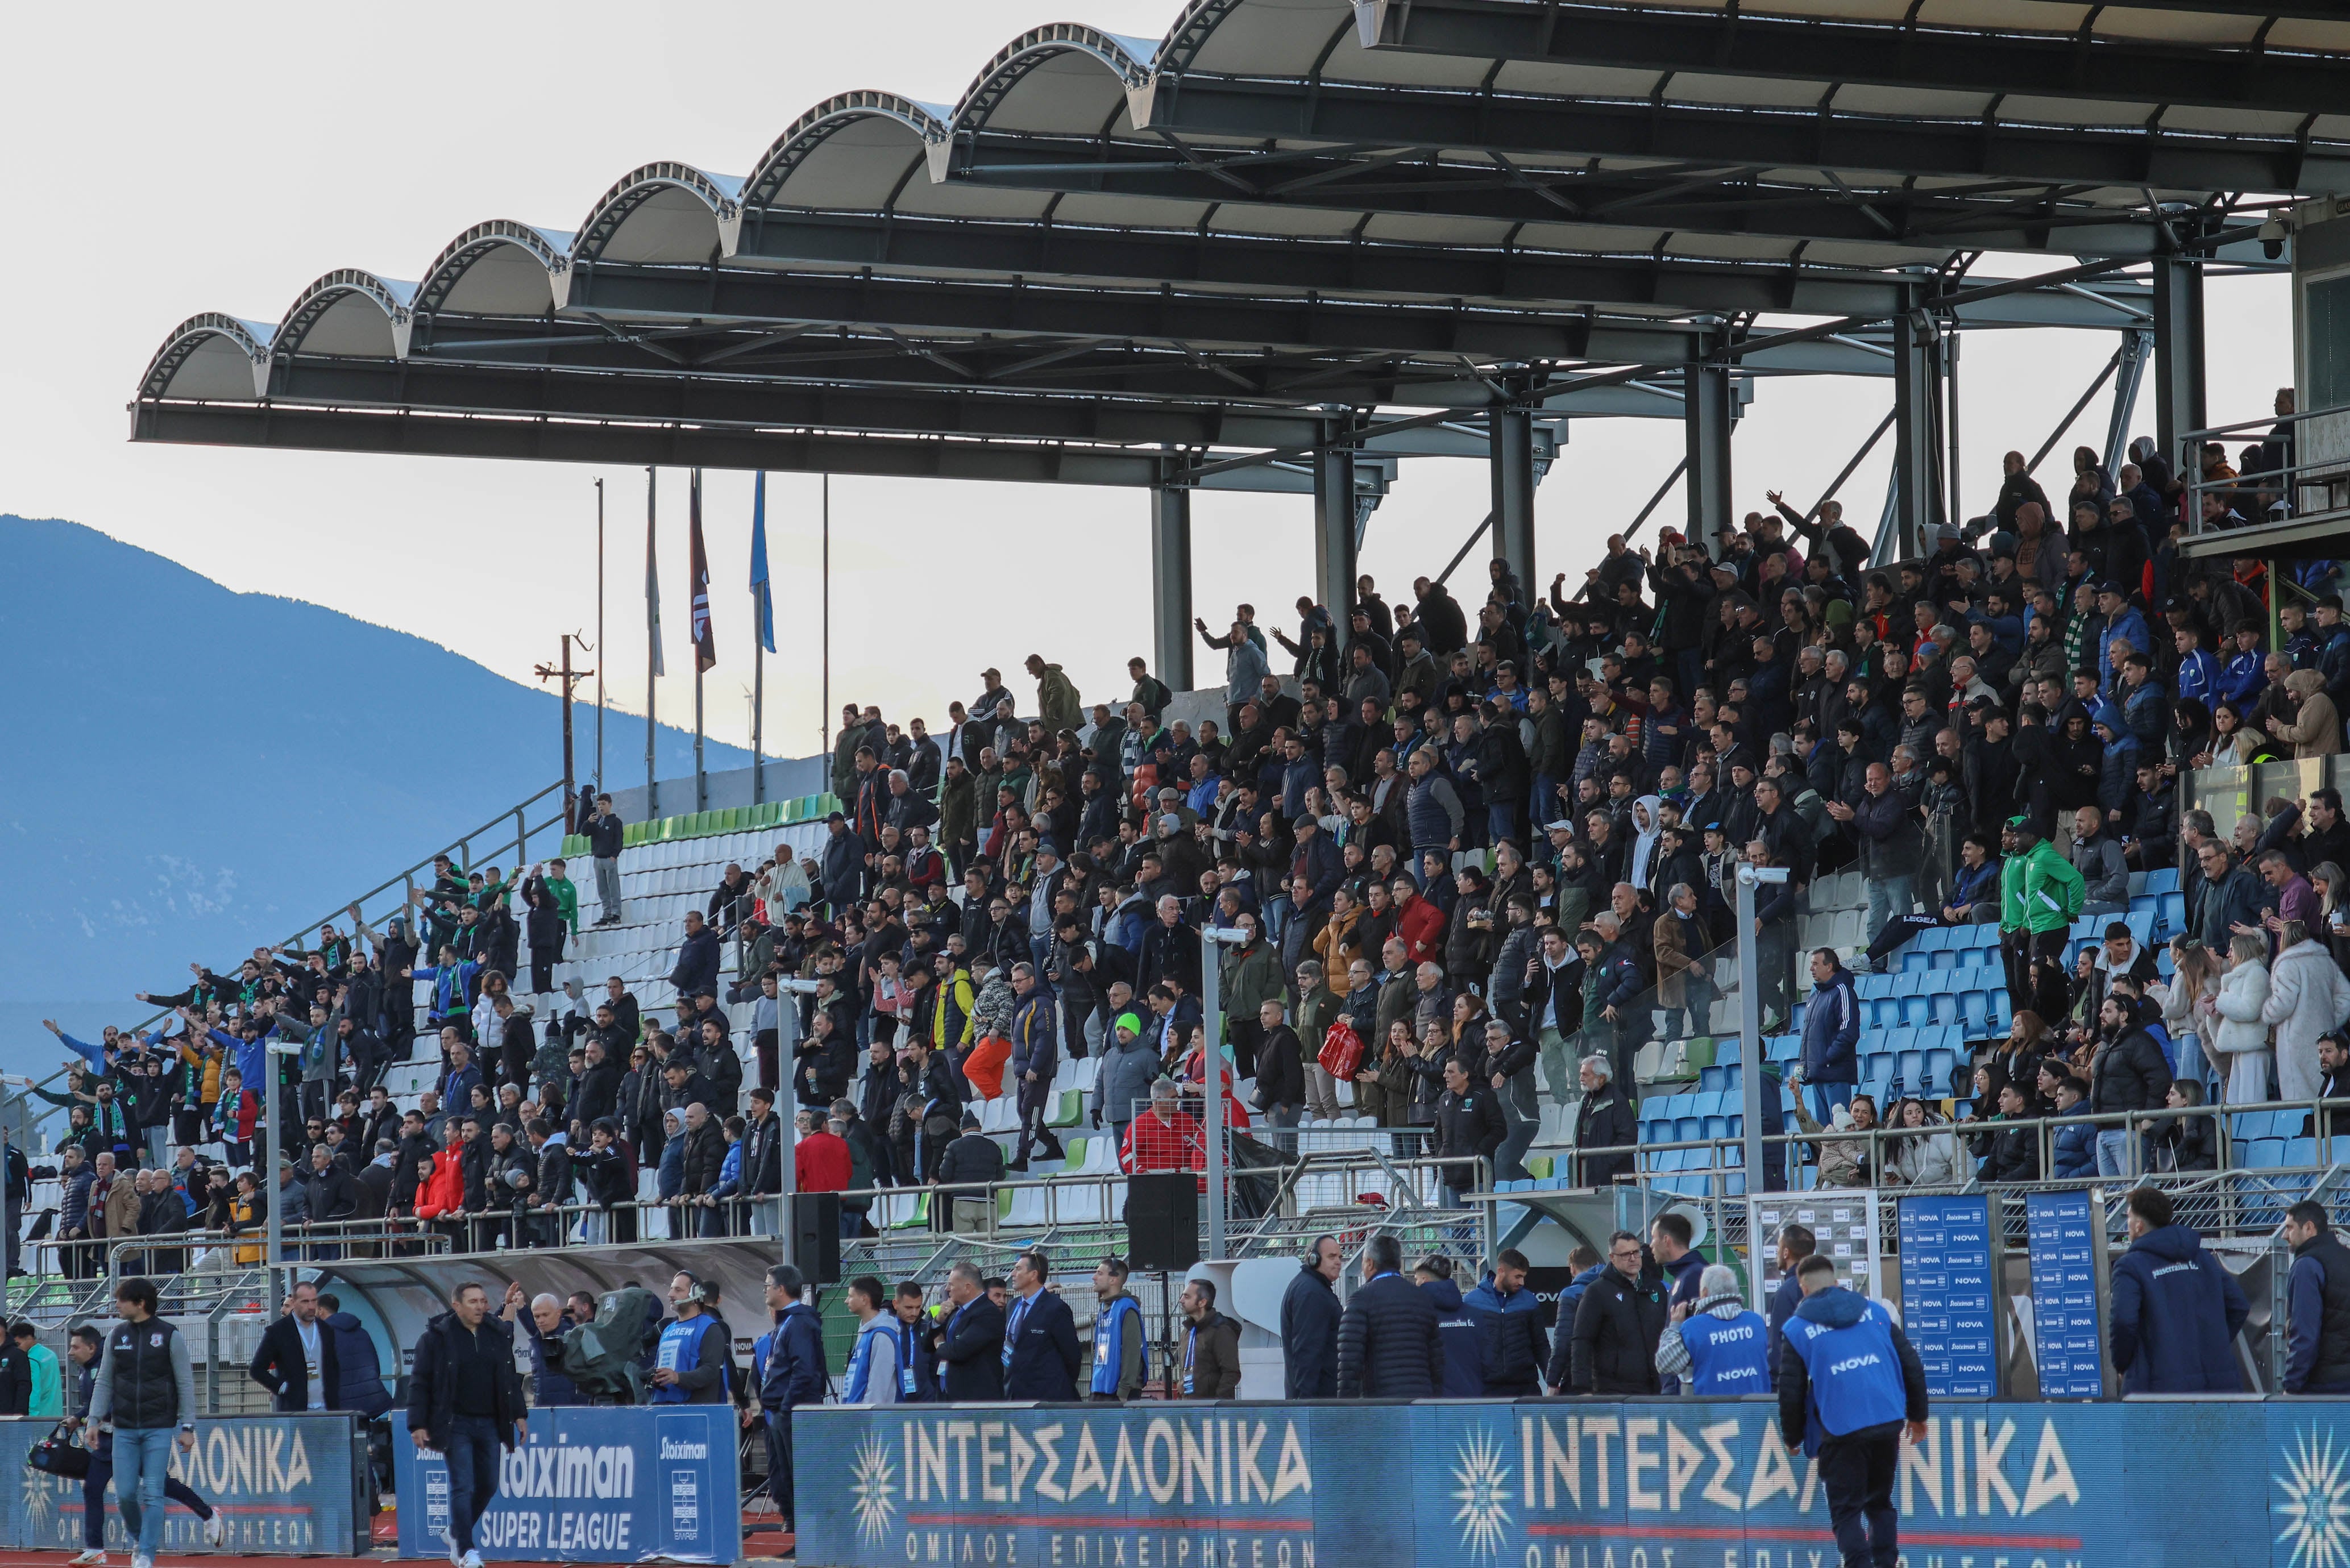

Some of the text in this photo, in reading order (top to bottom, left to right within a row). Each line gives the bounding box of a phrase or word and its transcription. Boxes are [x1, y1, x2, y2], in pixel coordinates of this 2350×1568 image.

[1903, 916, 1937, 925] LEGEA
[1533, 1293, 1559, 1301] OV
[669, 1327, 695, 1336] CREW
[1709, 1326, 1753, 1345] PHOTO
[735, 1342, 752, 1351] NOVA
[1717, 1367, 1758, 1382] NOVA
[1830, 1354, 1880, 1375] NOVA
[660, 1436, 706, 1460] Stoiximan
[499, 1433, 633, 1499] toiximan
[904, 1416, 1313, 1505] ΙΝΤΕΡΣΑΛΟΝΙΚΑ
[1522, 1415, 2081, 1517] ΙΝΤΕΡΣΑΝΙΚΑ
[480, 1511, 631, 1550] SUPER LEAGUE
[906, 1534, 1315, 1568] ΟΜΙΛΟΣ ΕΠΙΧΕΙΡΗΣΕΩΝ
